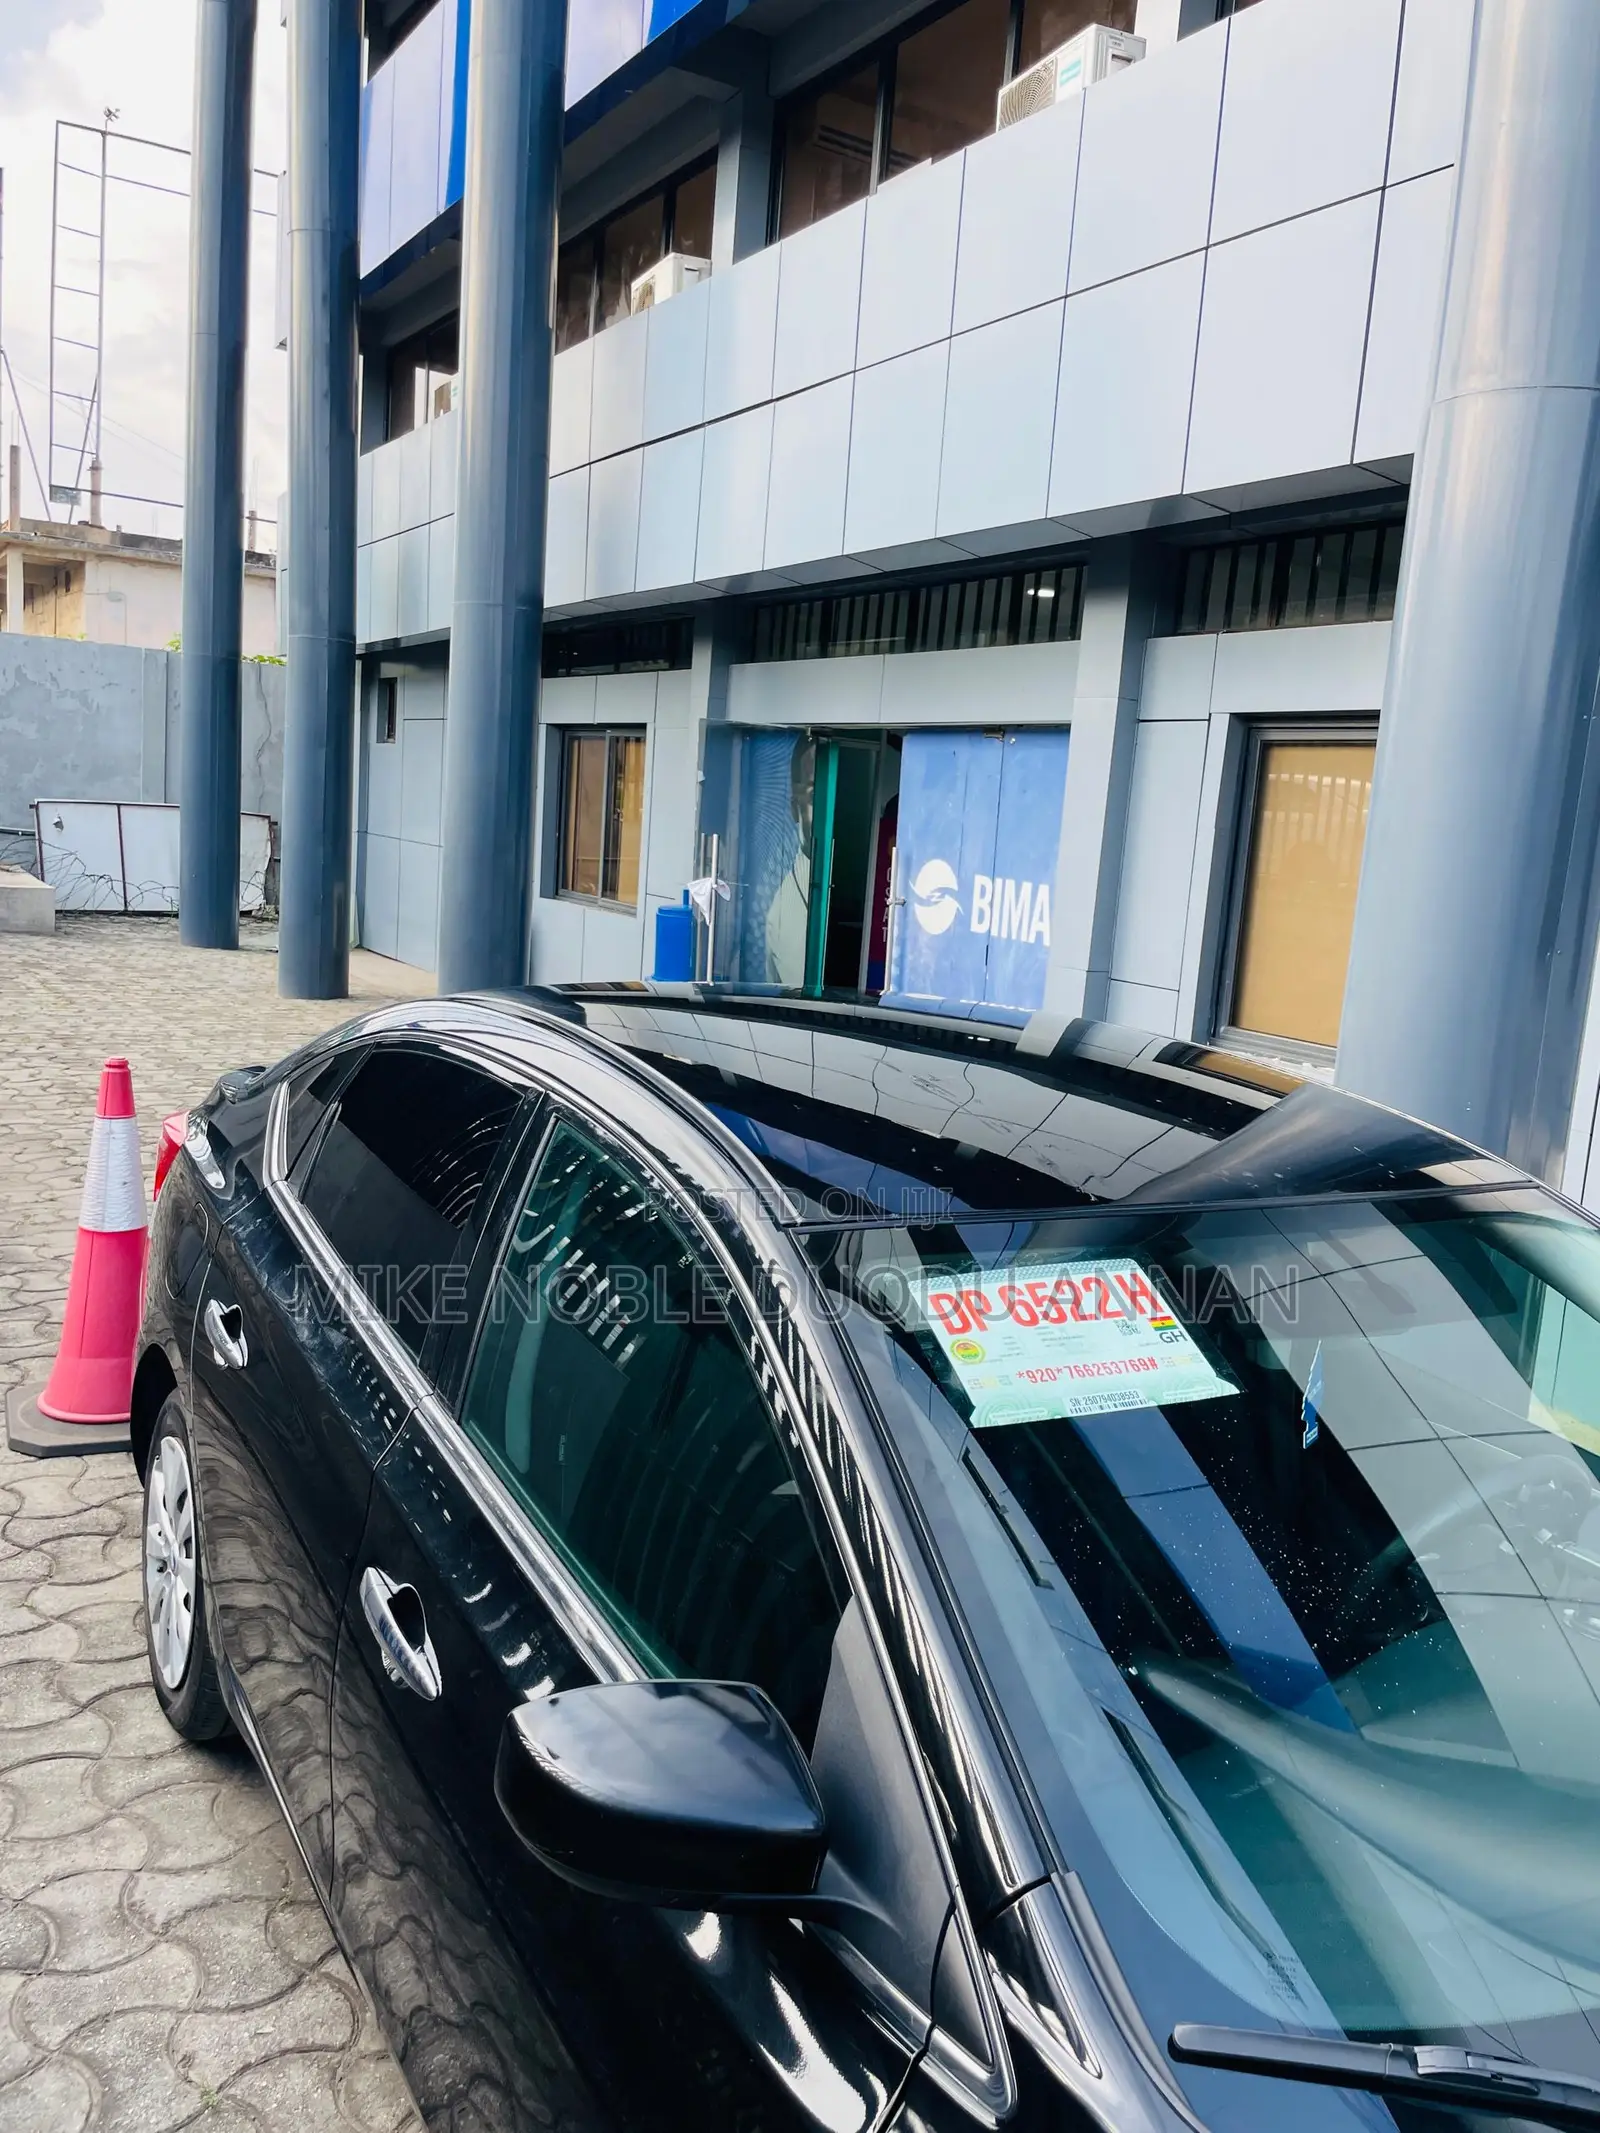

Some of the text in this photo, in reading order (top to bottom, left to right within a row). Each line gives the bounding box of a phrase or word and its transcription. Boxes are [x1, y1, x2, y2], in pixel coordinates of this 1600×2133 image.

[971, 875, 1051, 946] BIMA
[928, 1273, 1164, 1335] DP 6522 H
[1159, 1331, 1188, 1344] GH
